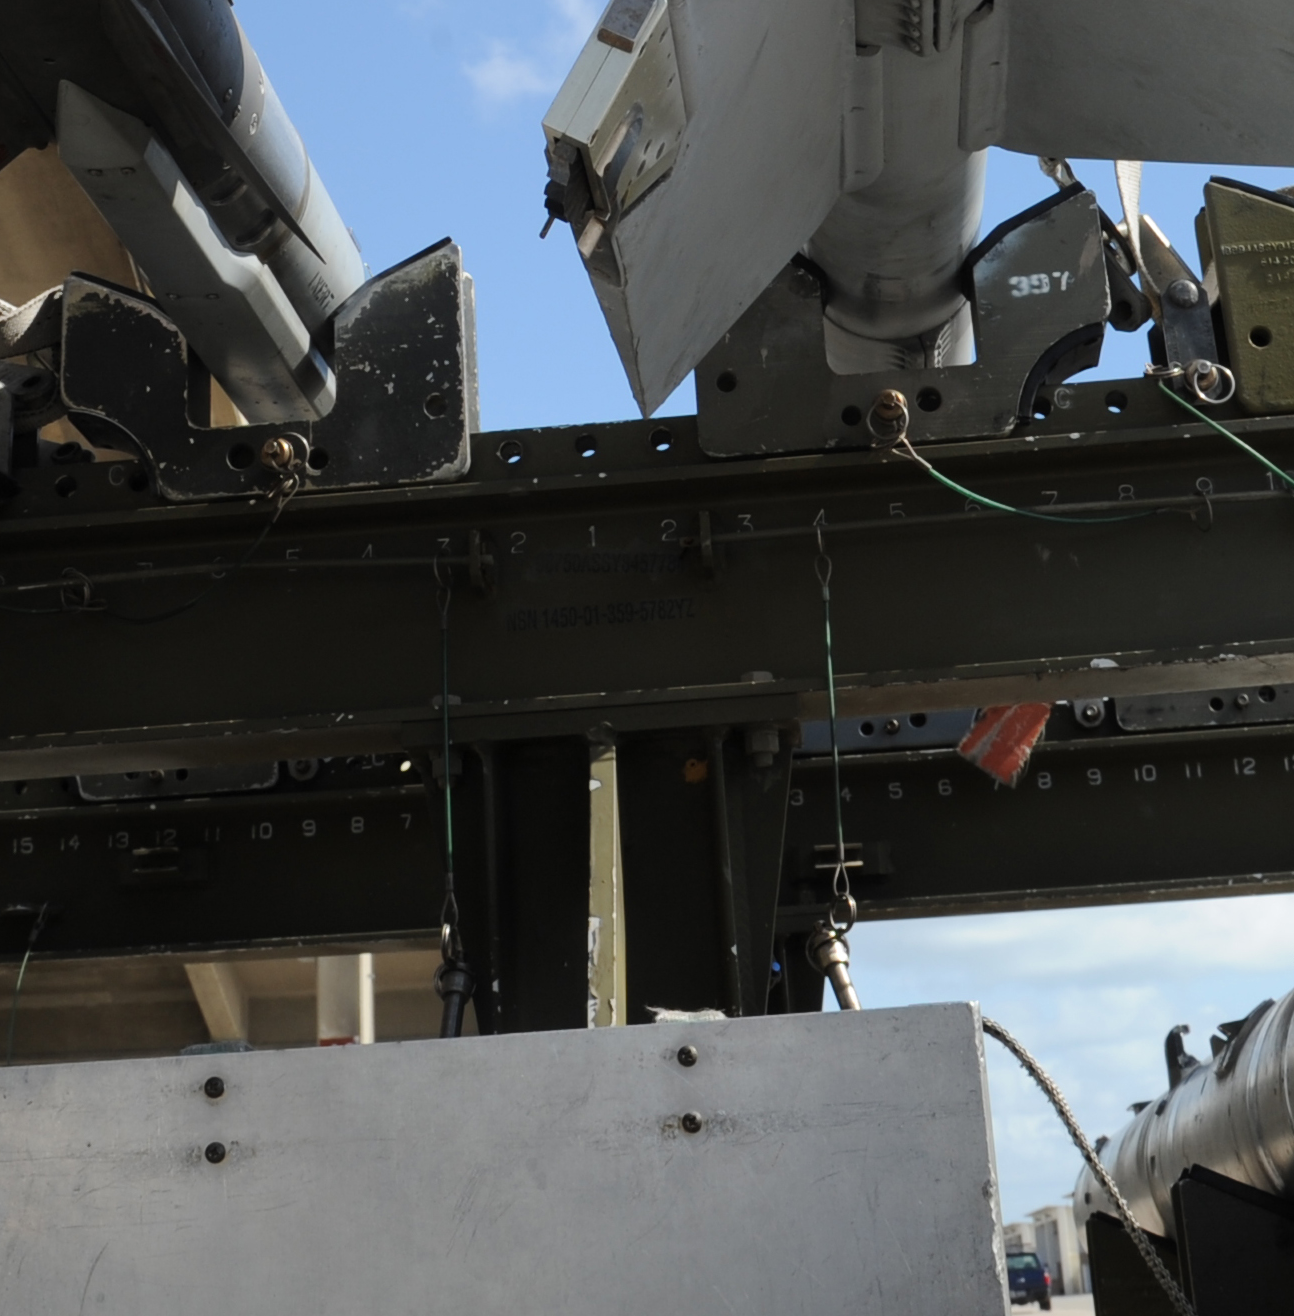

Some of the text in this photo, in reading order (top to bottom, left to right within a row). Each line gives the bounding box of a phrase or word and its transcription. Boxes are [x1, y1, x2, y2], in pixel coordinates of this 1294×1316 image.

[1008, 270, 1070, 298] 397
[510, 532, 527, 555] 2
[587, 524, 598, 547] 1
[660, 519, 678, 542] 2
[737, 513, 755, 534] 3
[812, 508, 829, 527] 4
[505, 609, 538, 632] NSN
[789, 790, 804, 806] 3
[888, 782, 903, 799] 5
[938, 779, 953, 796] 6
[1037, 772, 1052, 790] 8
[1087, 768, 1104, 786] 9
[1133, 765, 1157, 783] 10
[1185, 761, 1202, 780] 11
[1232, 756, 1257, 777] 12
[11, 837, 34, 855] 15
[59, 835, 81, 852] 14
[107, 831, 130, 849] 13
[251, 822, 273, 840] 10
[302, 819, 317, 837] 9
[350, 816, 365, 834] 8
[399, 813, 413, 830] 7
